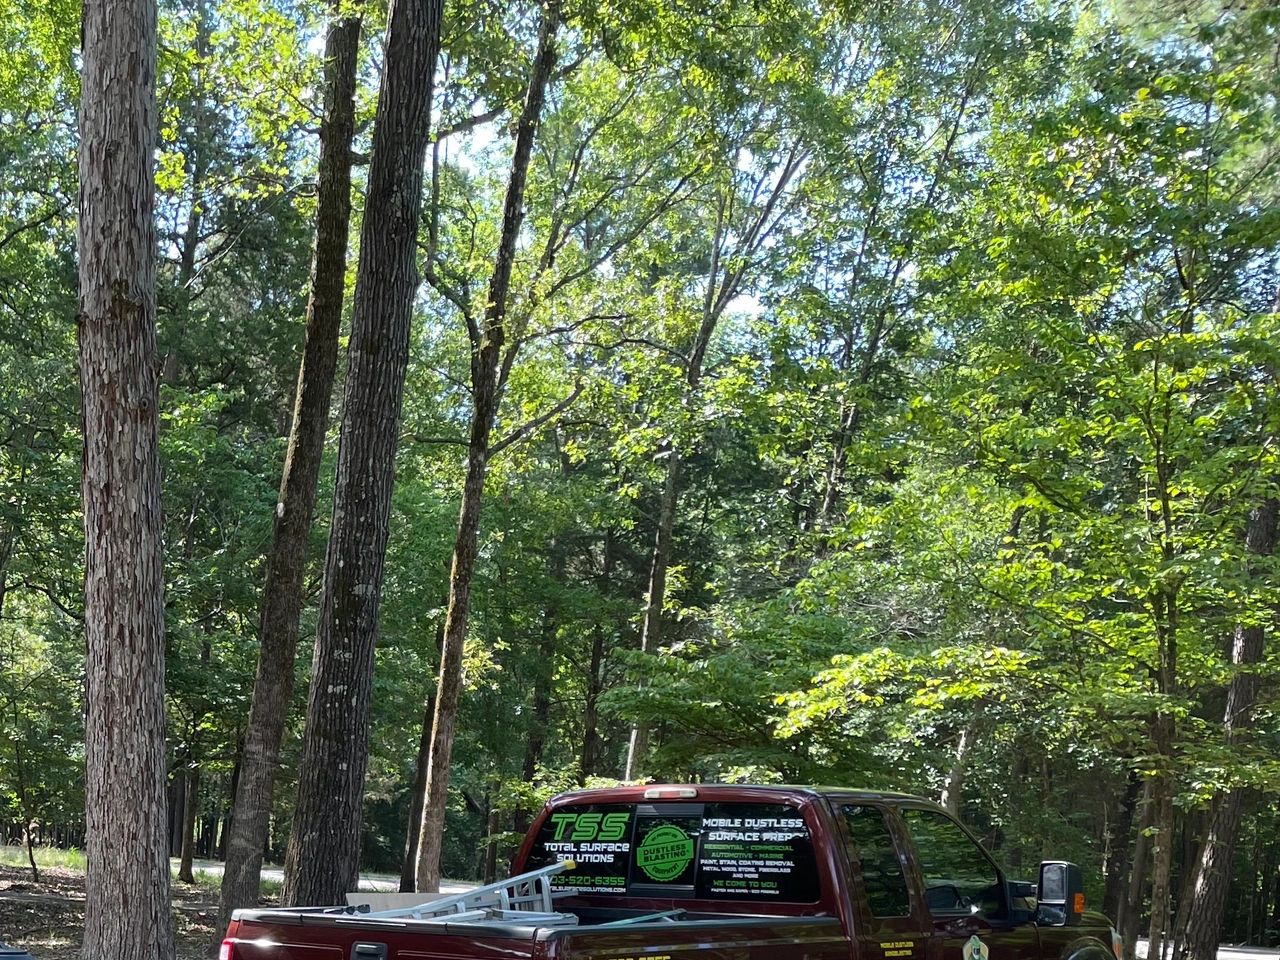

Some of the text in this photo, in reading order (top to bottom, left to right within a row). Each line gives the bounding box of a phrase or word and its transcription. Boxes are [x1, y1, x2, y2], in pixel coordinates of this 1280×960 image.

[551, 813, 630, 840] TSS
[702, 819, 803, 828] MOBILE DUSTLESS
[708, 832, 760, 841] SURFACE
[544, 842, 577, 851] TOTAL
[644, 844, 686, 855] DUSTLESS
[557, 854, 614, 863] SOLUTIONS
[644, 851, 686, 862] BLASTING
[550, 876, 625, 885] 03-520-6355
